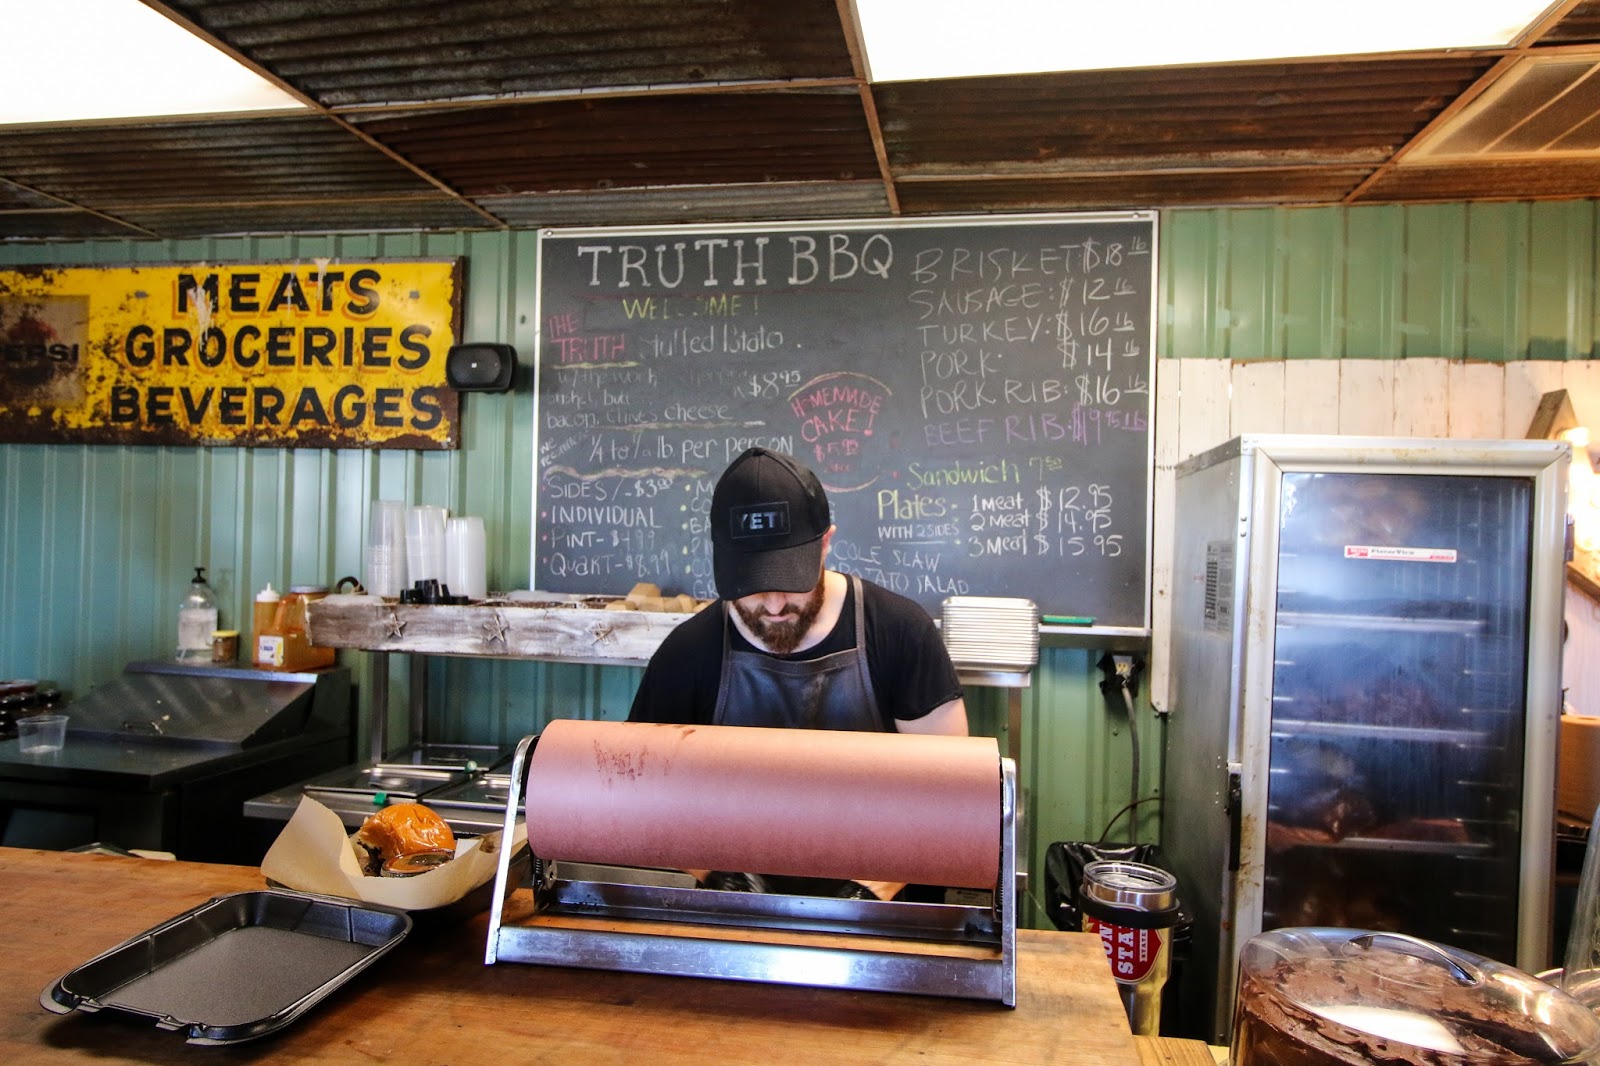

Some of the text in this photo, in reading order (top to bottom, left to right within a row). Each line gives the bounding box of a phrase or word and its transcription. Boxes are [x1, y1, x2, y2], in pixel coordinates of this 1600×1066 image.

[578, 234, 893, 288] TRUTH BBQ
[173, 269, 382, 316] MEATS
[1060, 276, 1110, 309] $12
[0, 343, 79, 362] EPSI
[122, 324, 432, 371] GROCERIES
[1057, 338, 1112, 371] $14
[111, 384, 443, 431] BEVERAGES
[921, 380, 997, 418] PORK
[1075, 373, 1120, 406] $16
[664, 403, 730, 422] cheese
[924, 418, 995, 447] BEEF
[682, 438, 718, 464] per
[551, 506, 662, 528] INDIVIDUAL
[833, 540, 940, 573] COLE SLAW
